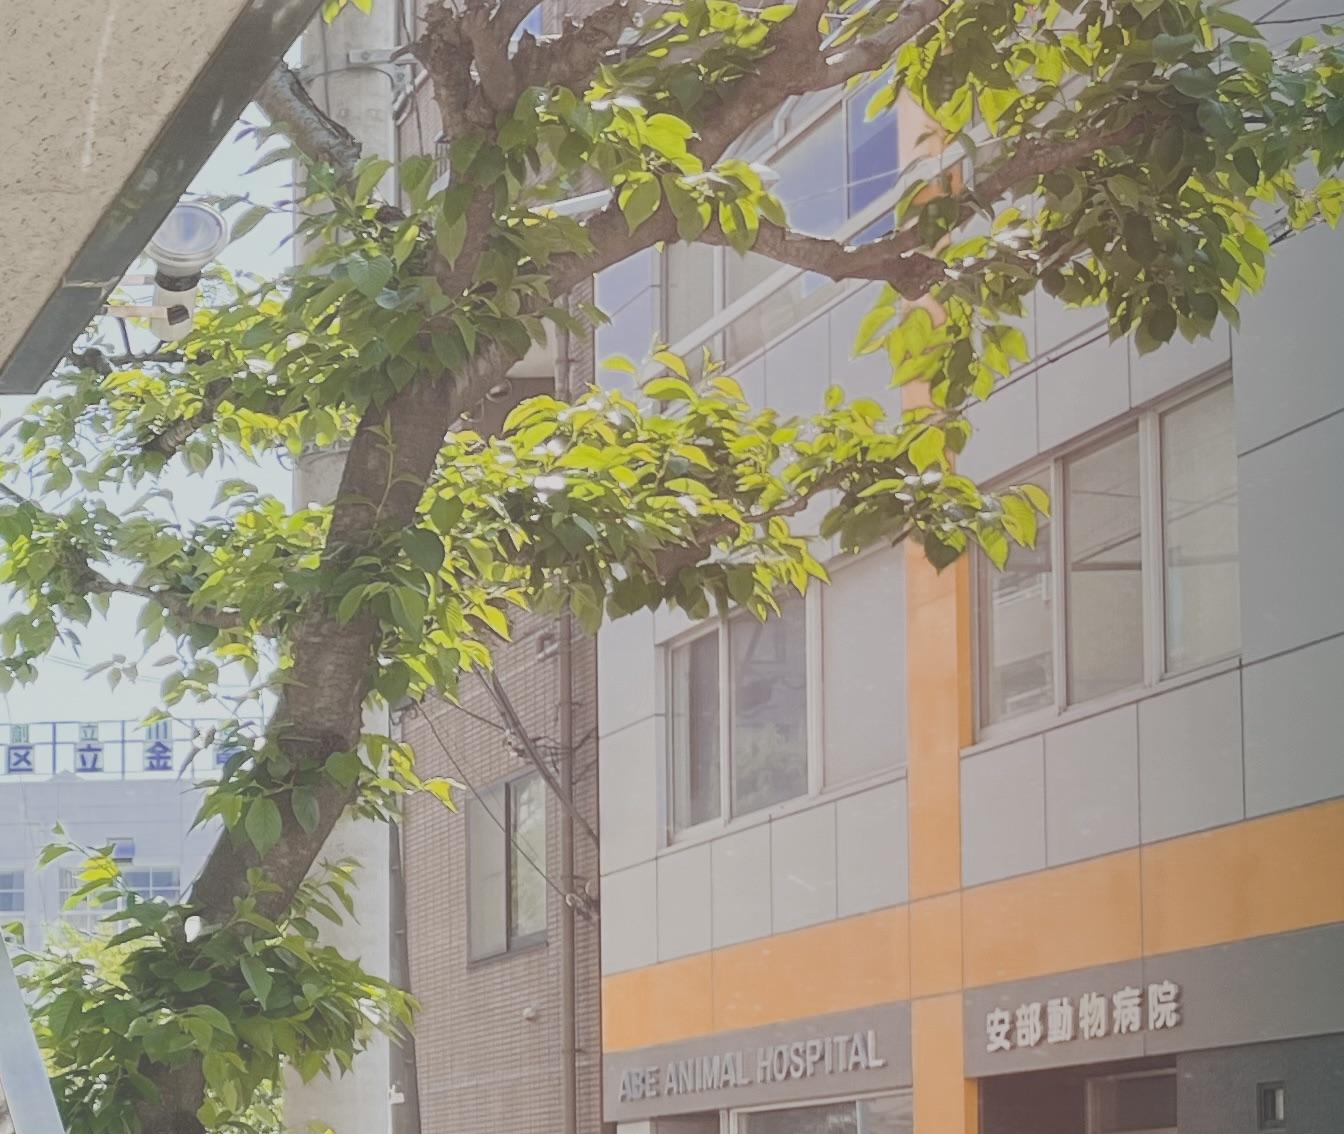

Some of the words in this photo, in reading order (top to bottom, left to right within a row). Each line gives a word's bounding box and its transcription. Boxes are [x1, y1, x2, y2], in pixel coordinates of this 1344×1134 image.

[986, 979, 1181, 1053] 安部動物病院
[619, 1064, 660, 1102] ABE
[664, 1050, 751, 1096] ANIMAL
[757, 1029, 887, 1083] HOSPITAL
